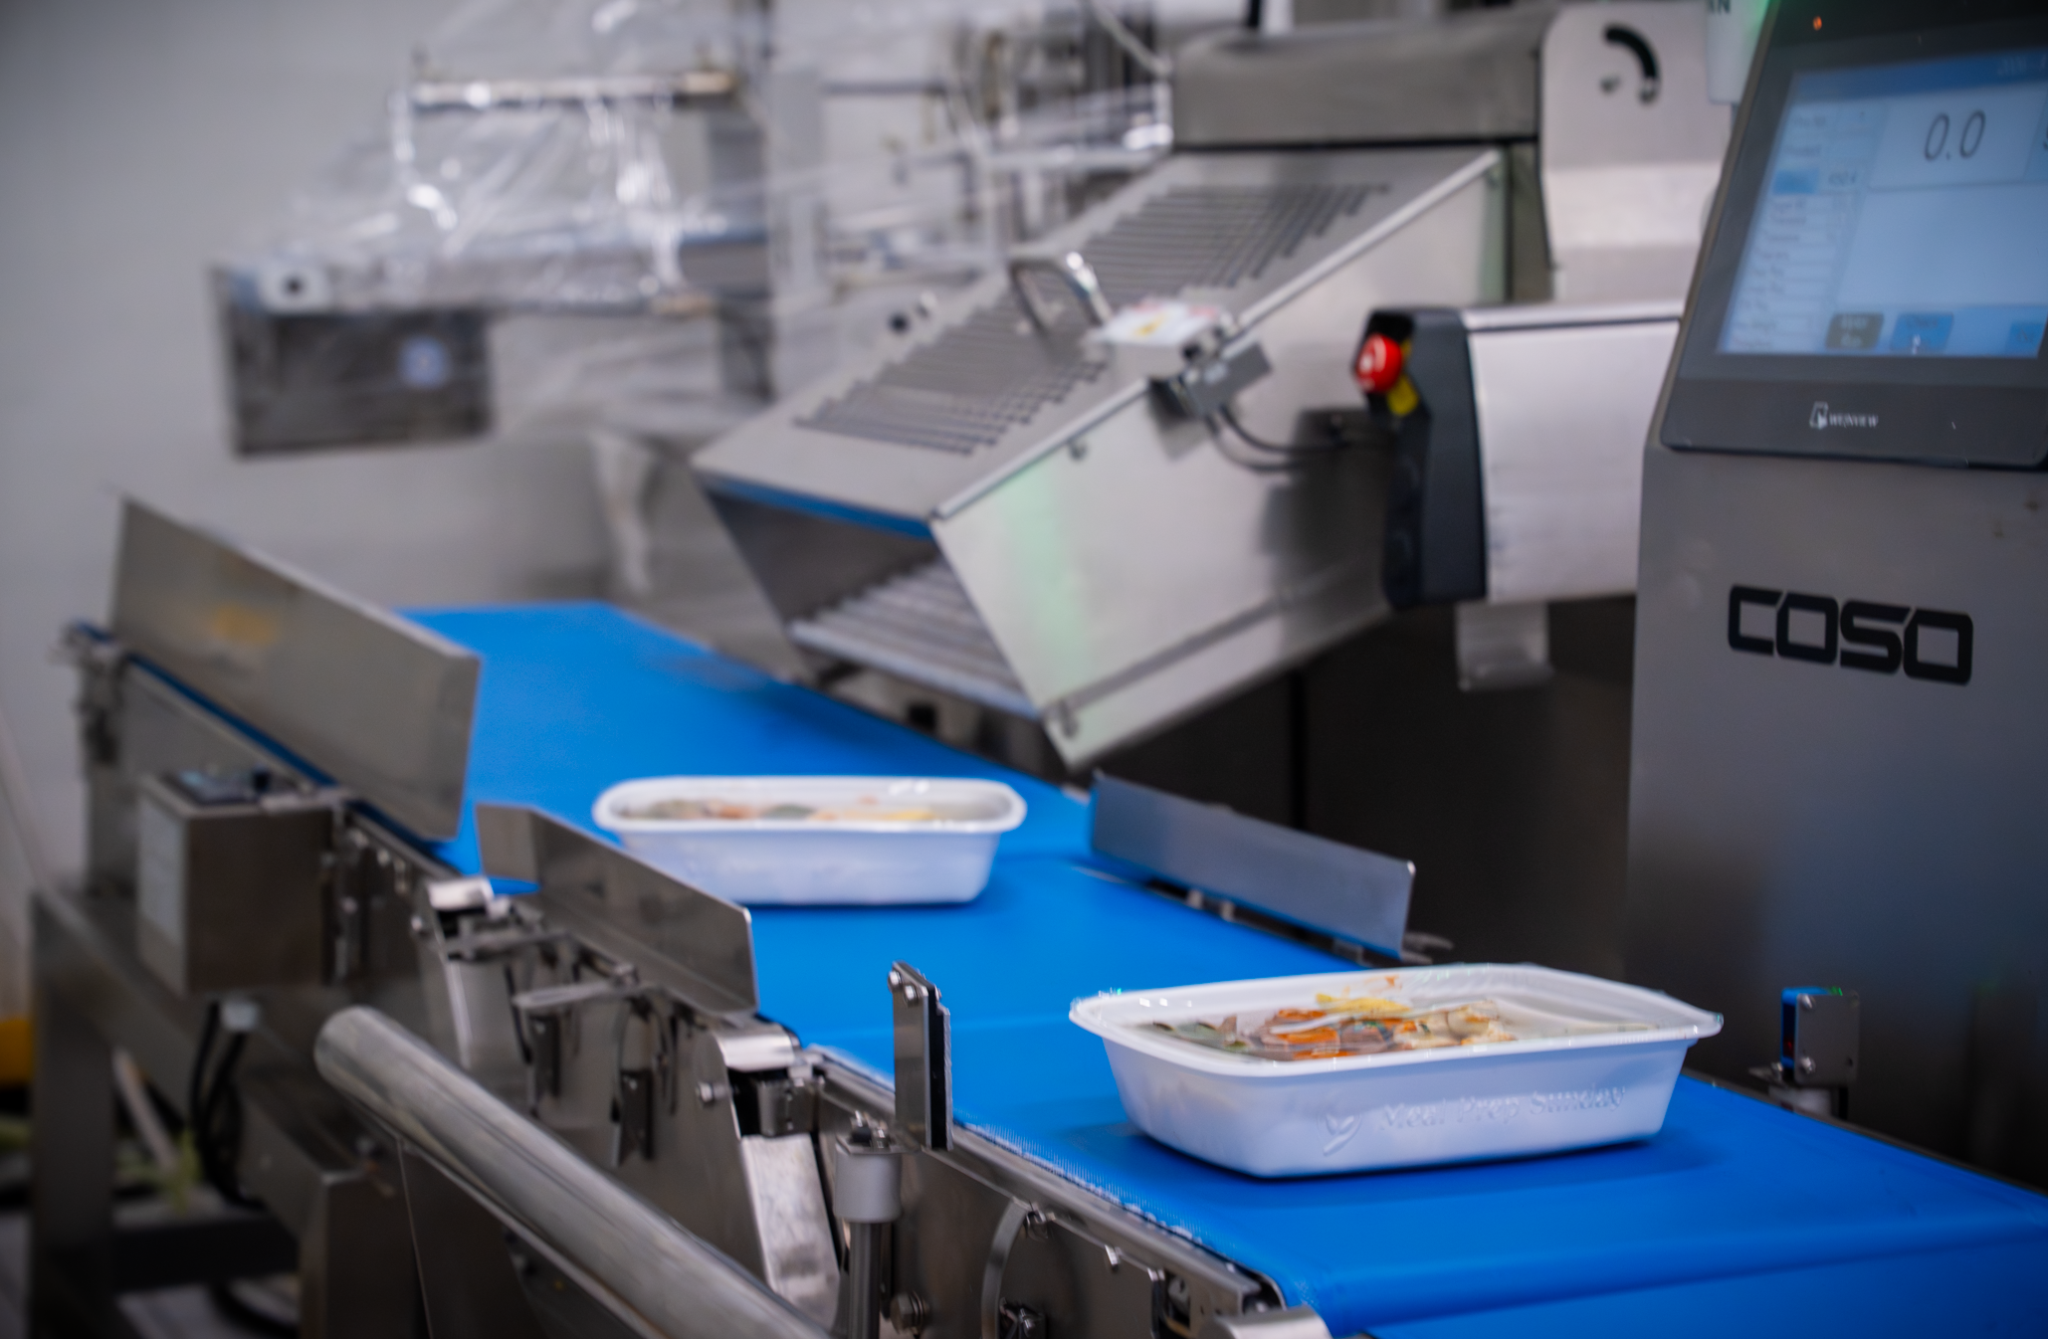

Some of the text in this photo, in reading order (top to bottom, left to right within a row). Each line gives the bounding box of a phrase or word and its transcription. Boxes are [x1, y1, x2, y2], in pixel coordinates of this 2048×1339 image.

[1923, 110, 1986, 162] 0.0
[1727, 583, 1974, 687] COSO
[1379, 1082, 1626, 1130] Meal Prep Sunday
